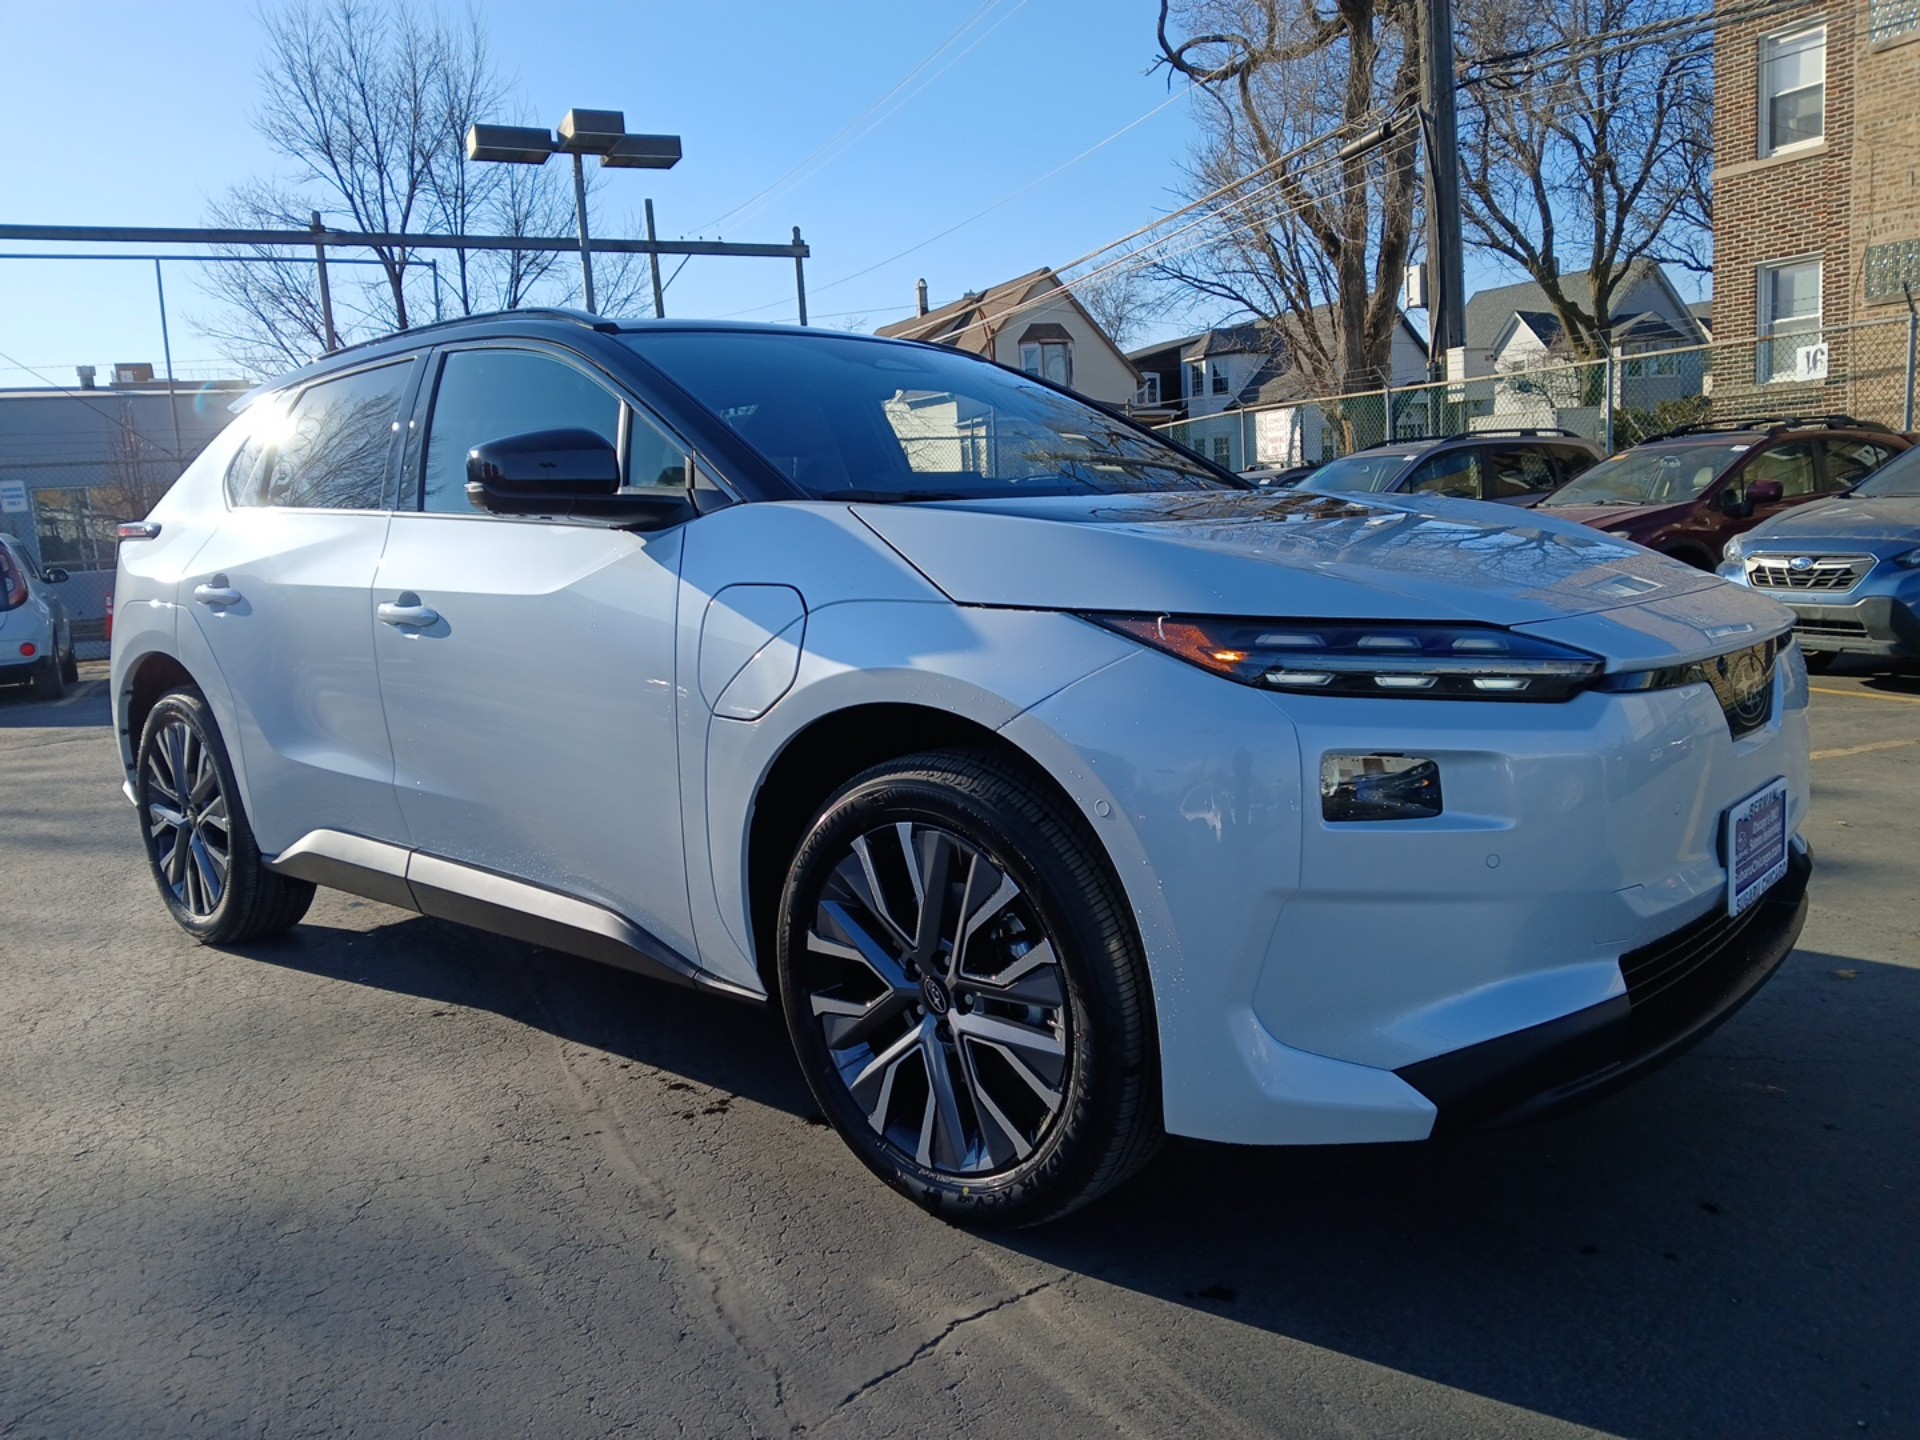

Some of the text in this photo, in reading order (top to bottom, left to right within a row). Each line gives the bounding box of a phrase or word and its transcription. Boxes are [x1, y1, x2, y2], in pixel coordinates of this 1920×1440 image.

[796, 802, 858, 872] YOKOHAMA
[1736, 860, 1786, 912] SUBARU CHICAGO
